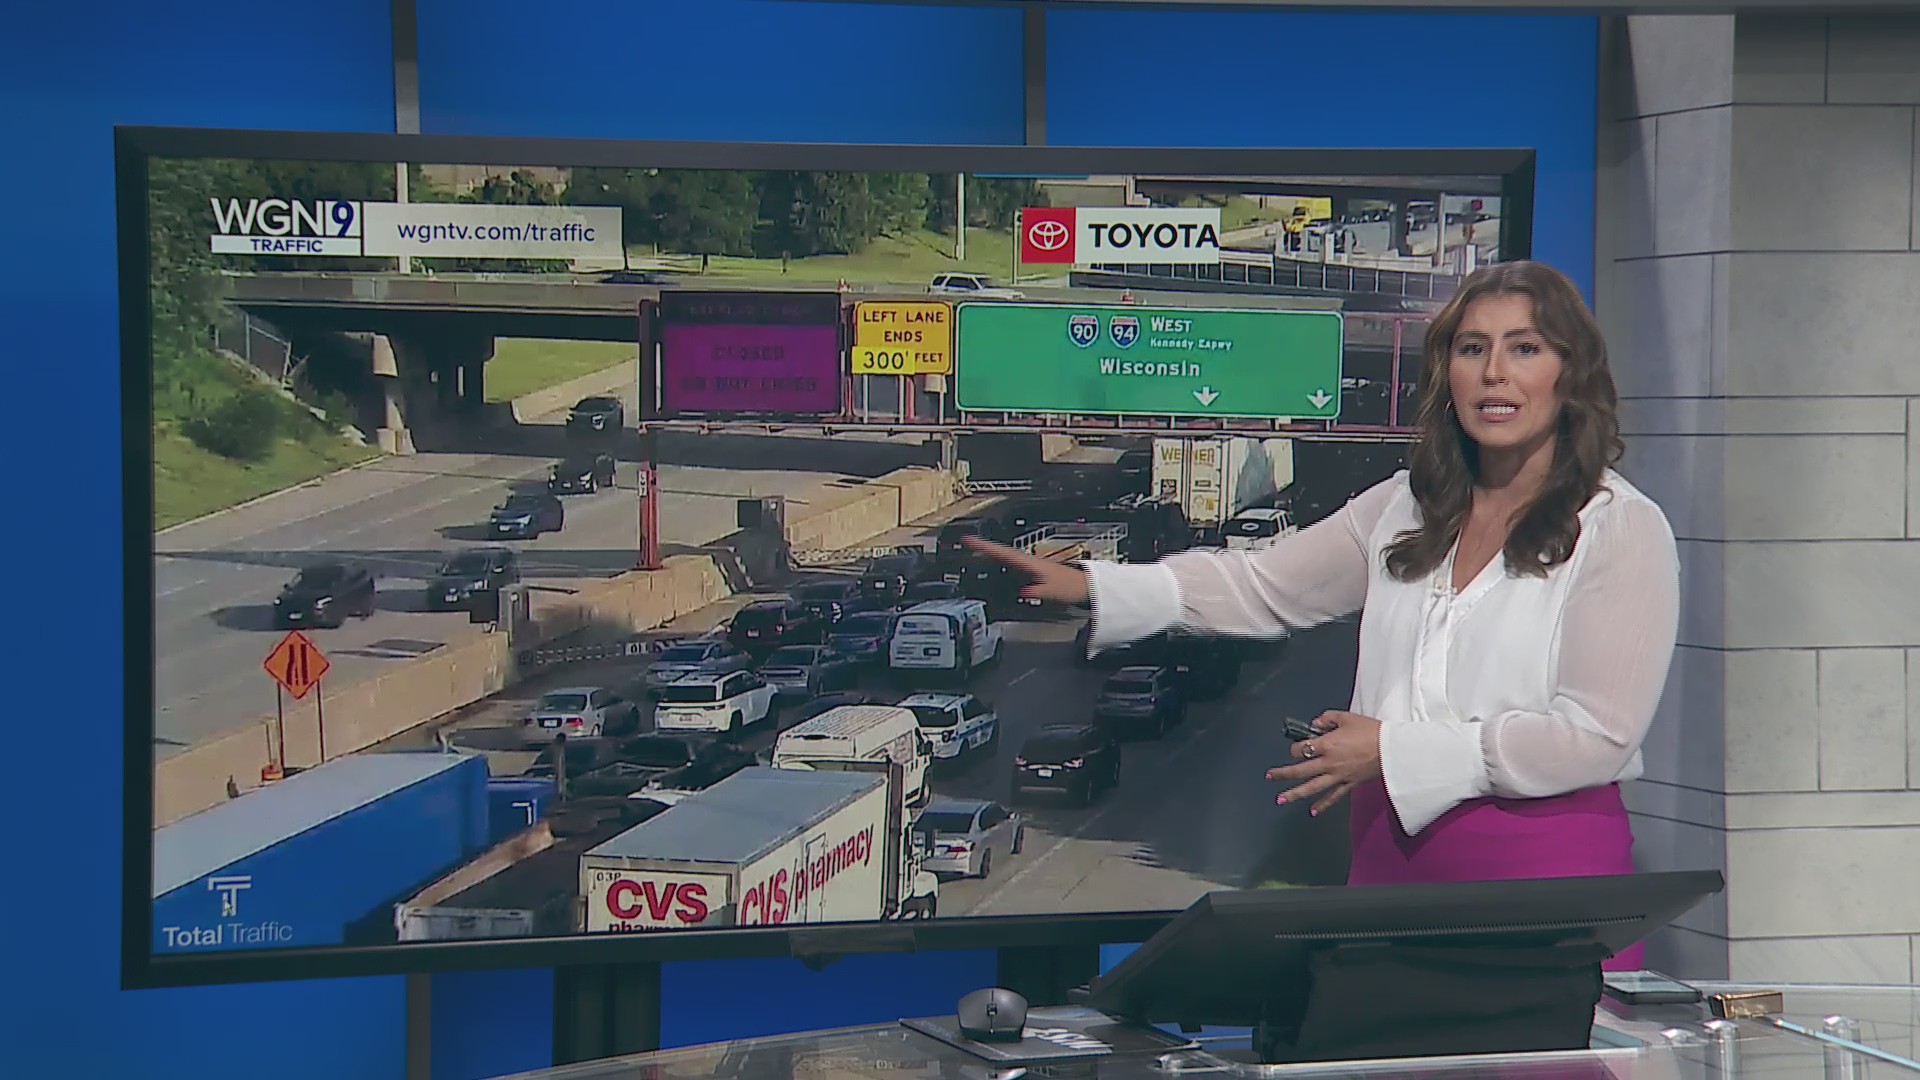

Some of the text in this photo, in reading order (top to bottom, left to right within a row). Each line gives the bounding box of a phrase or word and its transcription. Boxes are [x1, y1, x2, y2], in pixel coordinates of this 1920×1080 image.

[397, 222, 595, 243] wgntv.com/traffic
[1088, 223, 1219, 248] TOYOTA
[250, 239, 323, 252] TRAFFIC
[863, 311, 944, 323] LEFT LANE
[1151, 316, 1192, 333] WEST
[884, 330, 922, 342] ENDS
[1073, 325, 1093, 340] 90
[1114, 325, 1135, 341] 94
[915, 352, 943, 363] FEET
[1100, 358, 1200, 376] Wisconsin
[606, 879, 708, 924] CVS
[163, 921, 293, 947] Total Traffic
